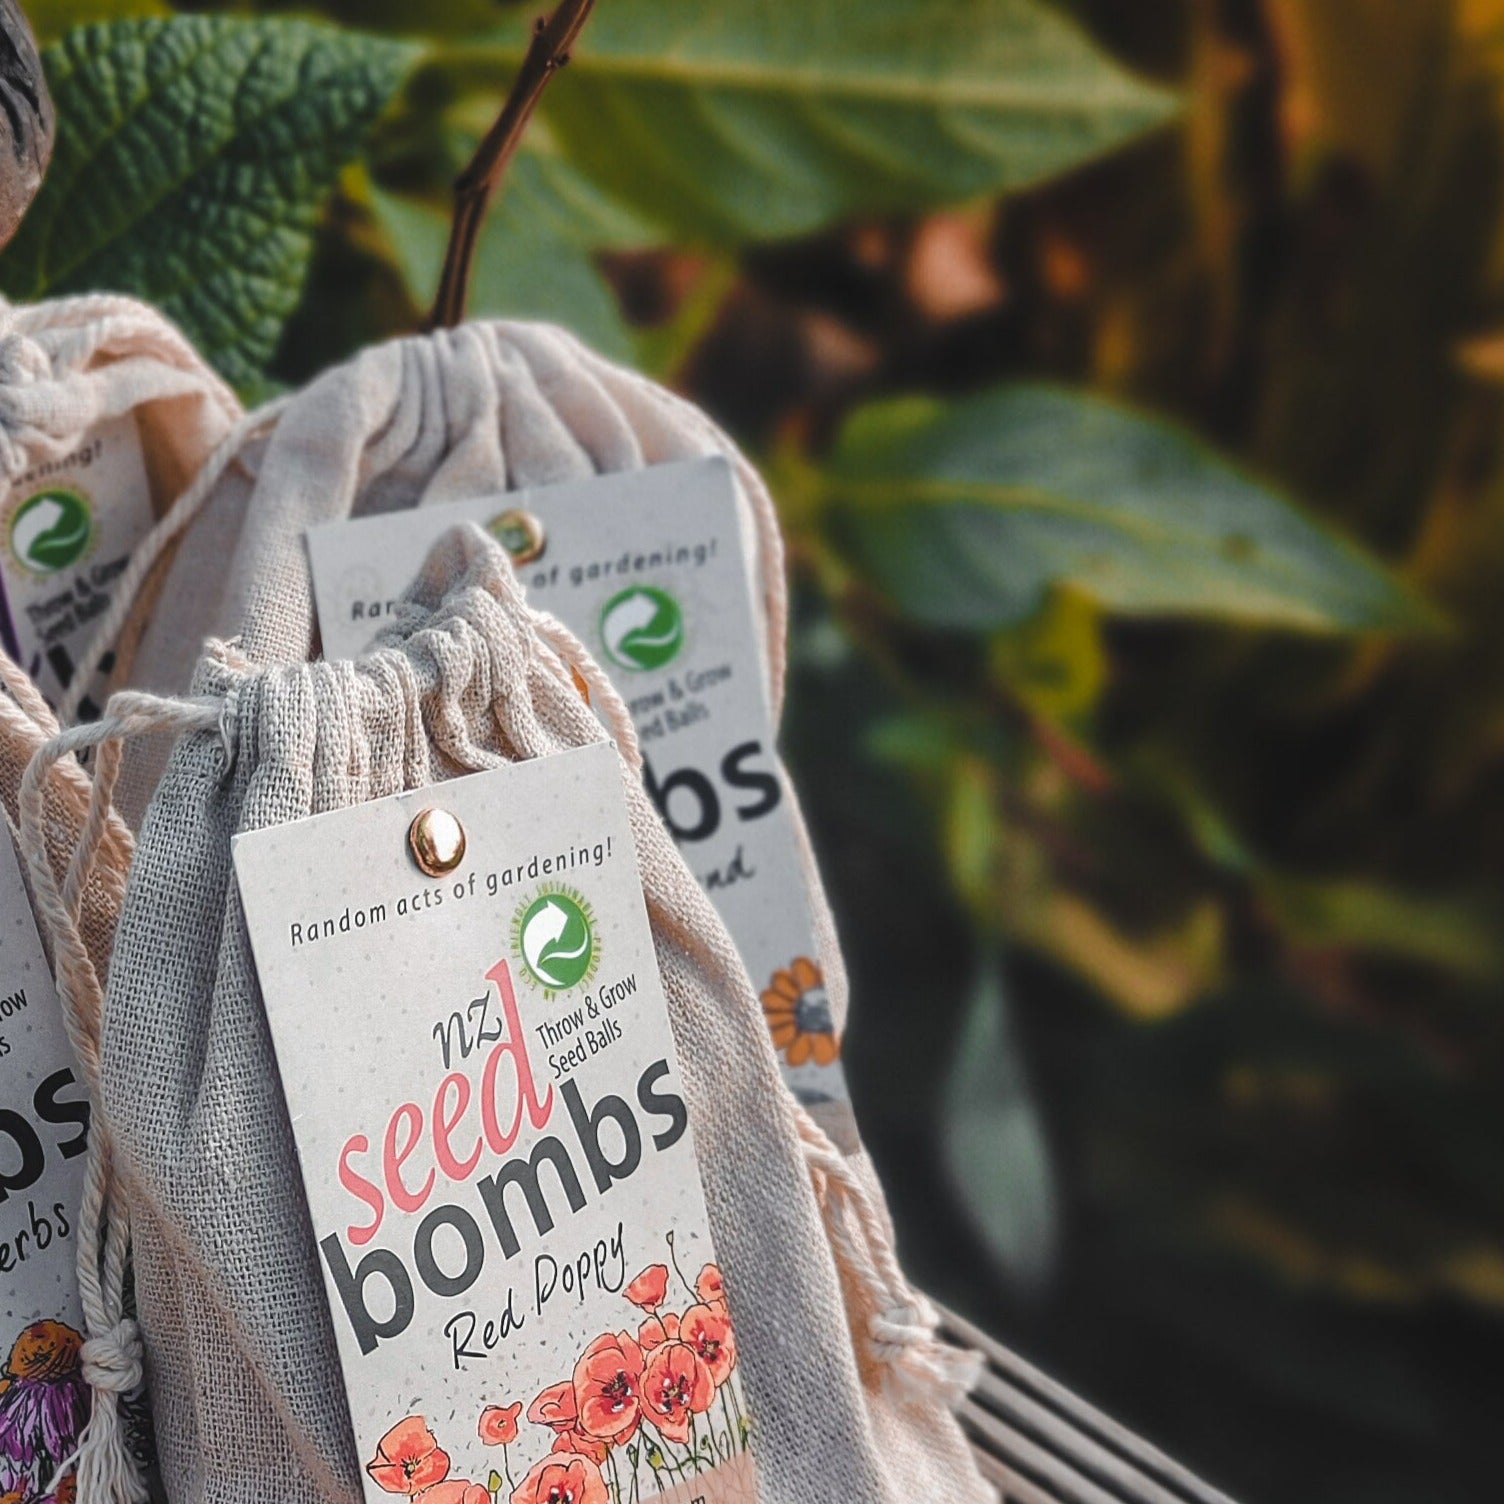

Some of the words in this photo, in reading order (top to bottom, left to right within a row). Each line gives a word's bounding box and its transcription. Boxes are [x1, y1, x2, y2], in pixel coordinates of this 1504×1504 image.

[532, 570, 559, 589] of
[290, 902, 387, 947] Random
[396, 885, 443, 917] acts
[452, 872, 477, 901] of
[485, 836, 613, 897] gardening!
[432, 990, 503, 1071] nz
[535, 1007, 585, 1050] Throw
[585, 995, 601, 1020] &
[598, 973, 638, 1011] Grow
[548, 1036, 589, 1080] Seed
[584, 1017, 623, 1056] Balls
[337, 957, 554, 1246] seed
[319, 1058, 688, 1357] bombs
[443, 1287, 526, 1371] Red
[533, 1221, 626, 1317] Poppy
